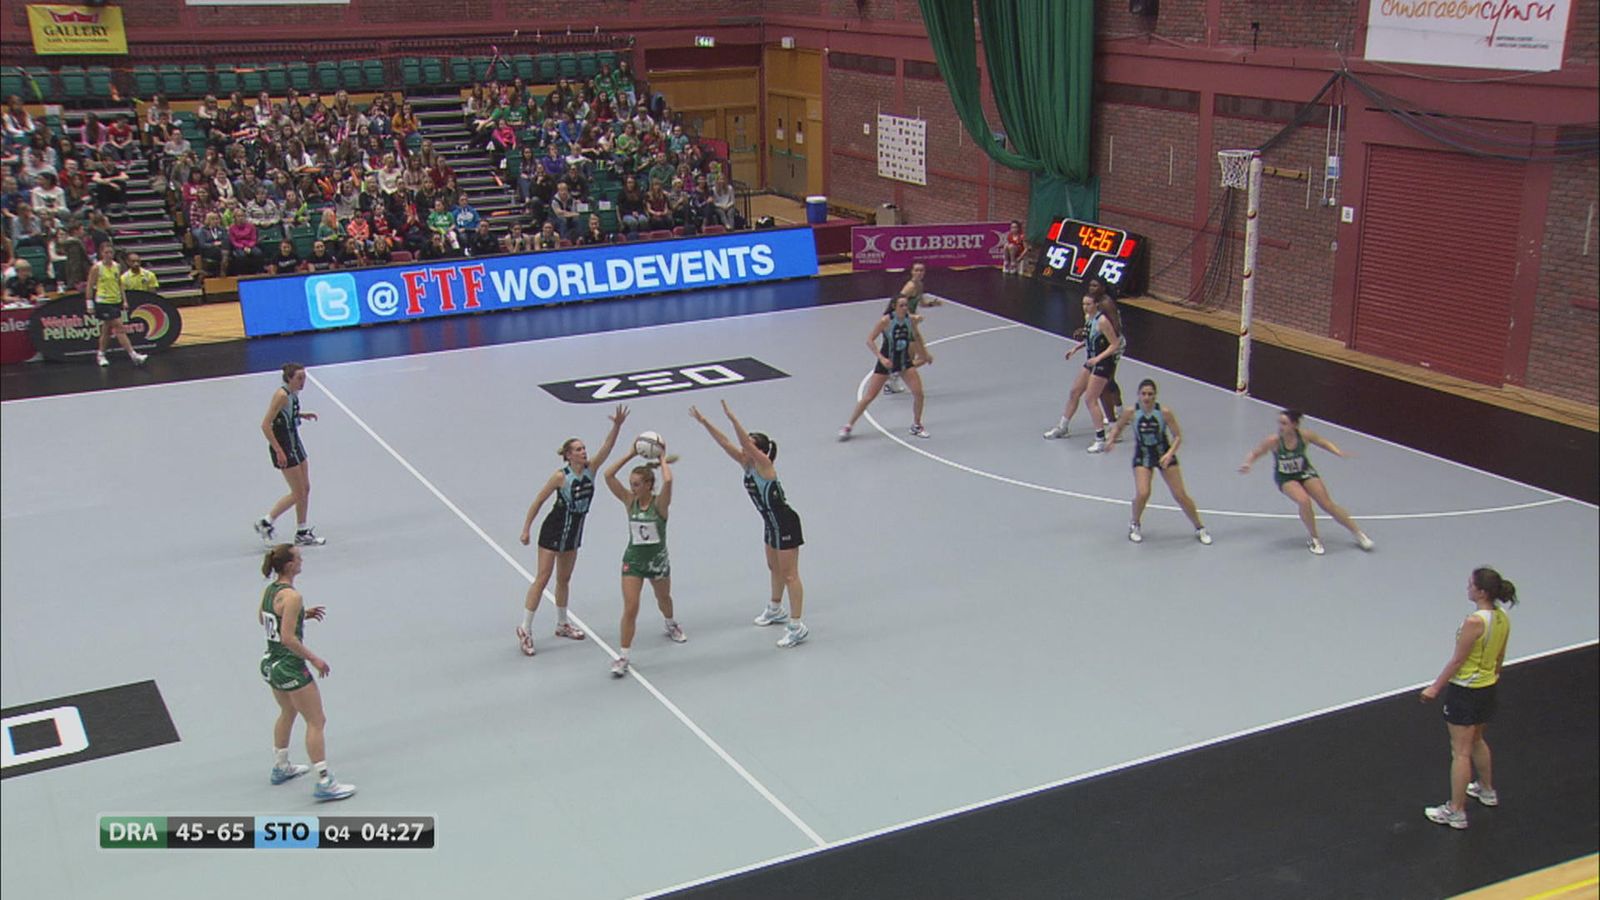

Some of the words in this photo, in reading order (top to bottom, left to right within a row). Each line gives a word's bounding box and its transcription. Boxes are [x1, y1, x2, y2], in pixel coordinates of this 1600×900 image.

[890, 234, 985, 251] GILBERT
[1078, 225, 1116, 252] 4:26
[1046, 245, 1070, 269] 45
[40, 314, 82, 328] Welsh
[639, 524, 650, 541] C
